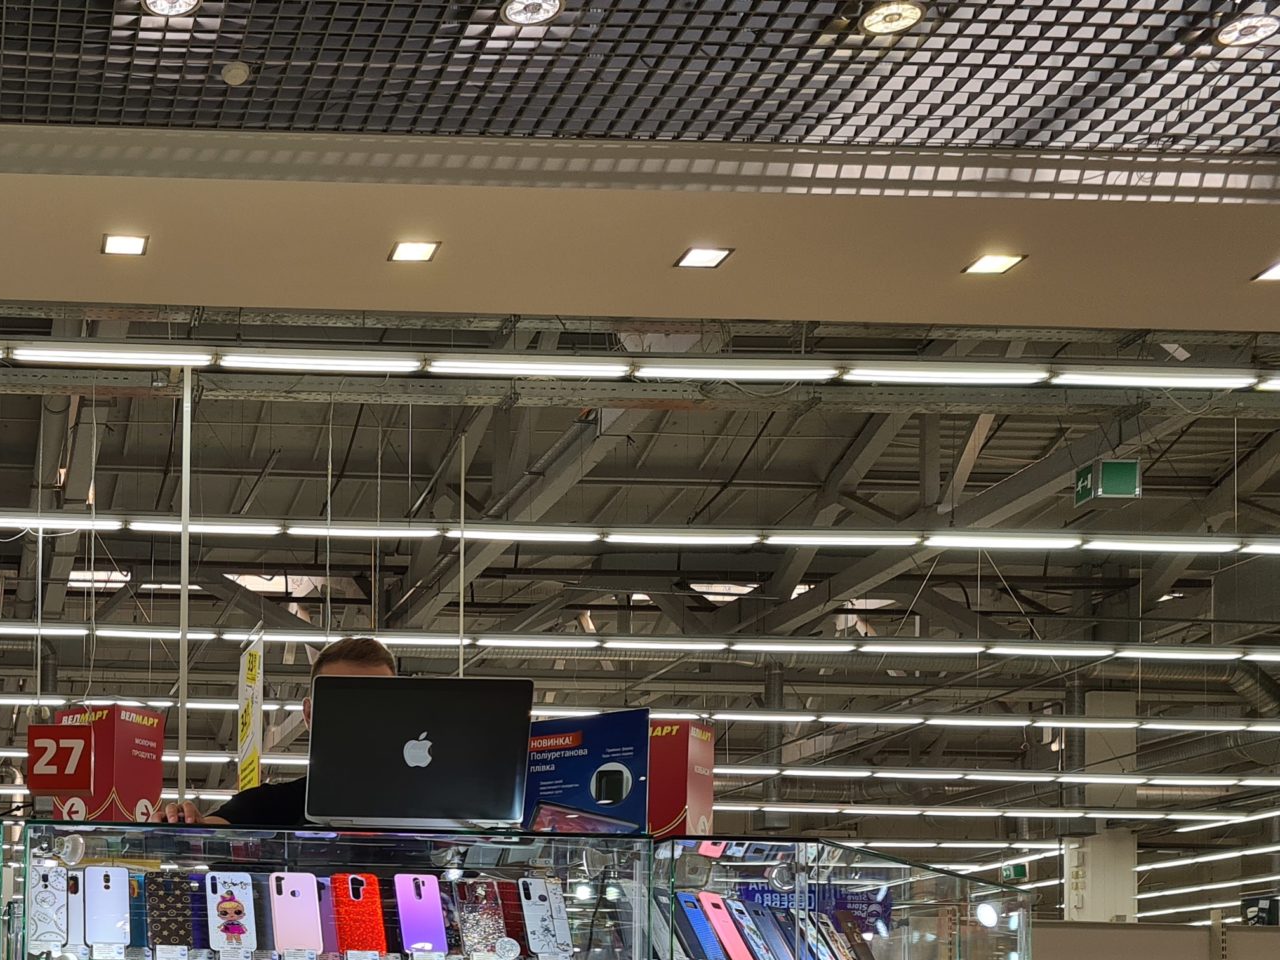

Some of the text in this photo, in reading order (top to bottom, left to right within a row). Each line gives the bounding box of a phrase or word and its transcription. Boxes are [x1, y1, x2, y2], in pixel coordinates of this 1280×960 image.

[120, 710, 159, 728] ВЕЛМАРТ
[530, 736, 573, 749] НОВИНКА!
[33, 738, 85, 775] 27
[530, 748, 588, 761] Поліуретанова
[530, 764, 555, 773] плівка
